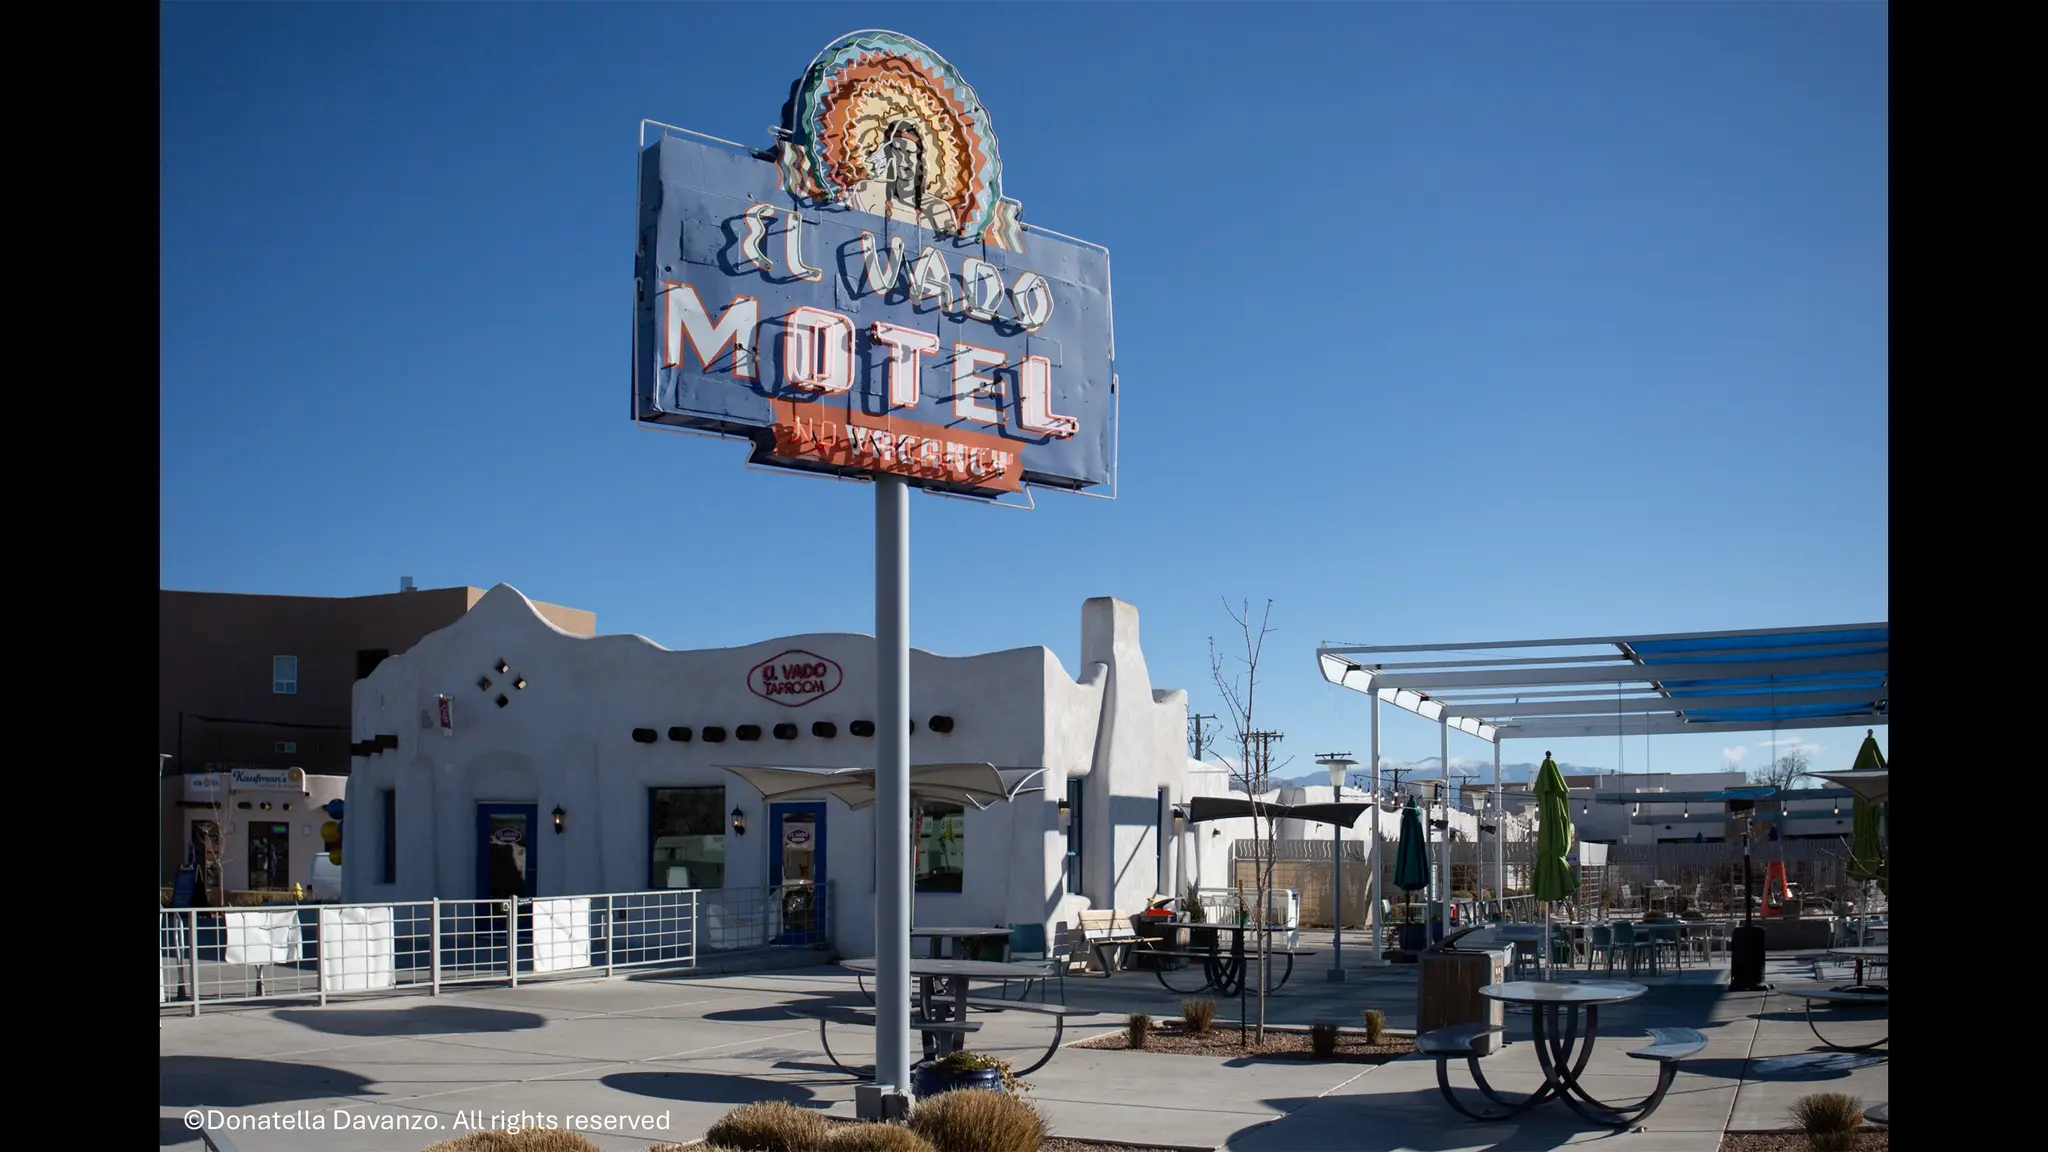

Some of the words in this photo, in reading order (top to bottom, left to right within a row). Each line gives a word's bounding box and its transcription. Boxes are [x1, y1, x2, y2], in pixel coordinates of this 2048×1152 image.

[743, 203, 822, 282] EL
[860, 229, 1055, 333] VADO
[664, 279, 1080, 438] MOTEL
[845, 423, 1014, 480] VACANCY
[762, 664, 778, 681] EL
[782, 662, 827, 680] VADO
[763, 680, 825, 696] TAPROOM
[233, 770, 287, 784] Kaufman's
